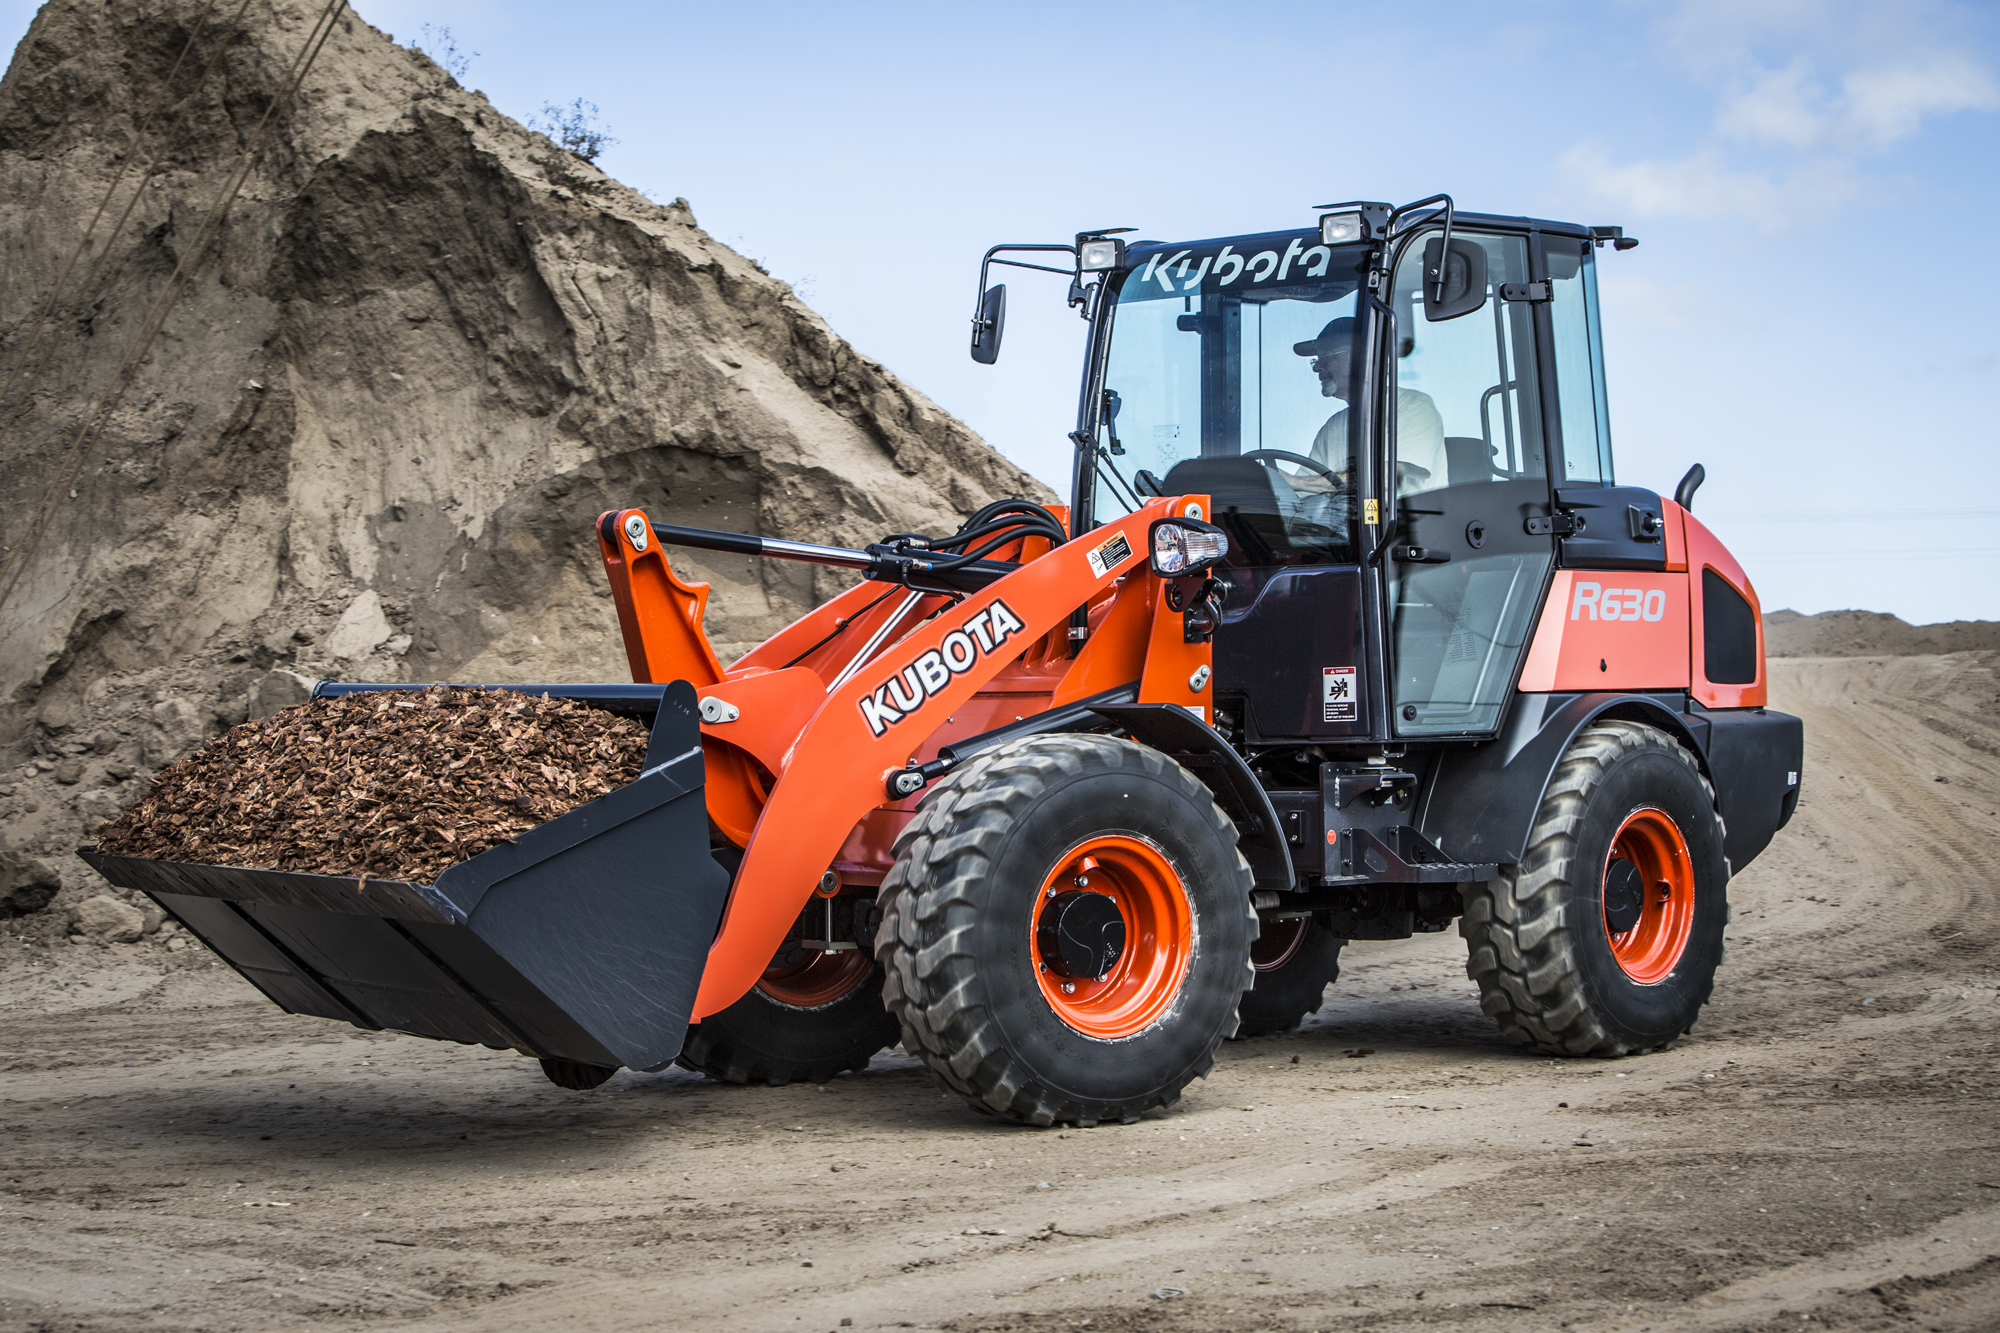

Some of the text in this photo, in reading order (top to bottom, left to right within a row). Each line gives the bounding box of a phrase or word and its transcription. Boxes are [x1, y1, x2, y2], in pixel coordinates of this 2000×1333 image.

[1141, 238, 1332, 293] Kubota
[1570, 581, 1666, 622] R630
[859, 600, 1024, 737] KUBOTA
